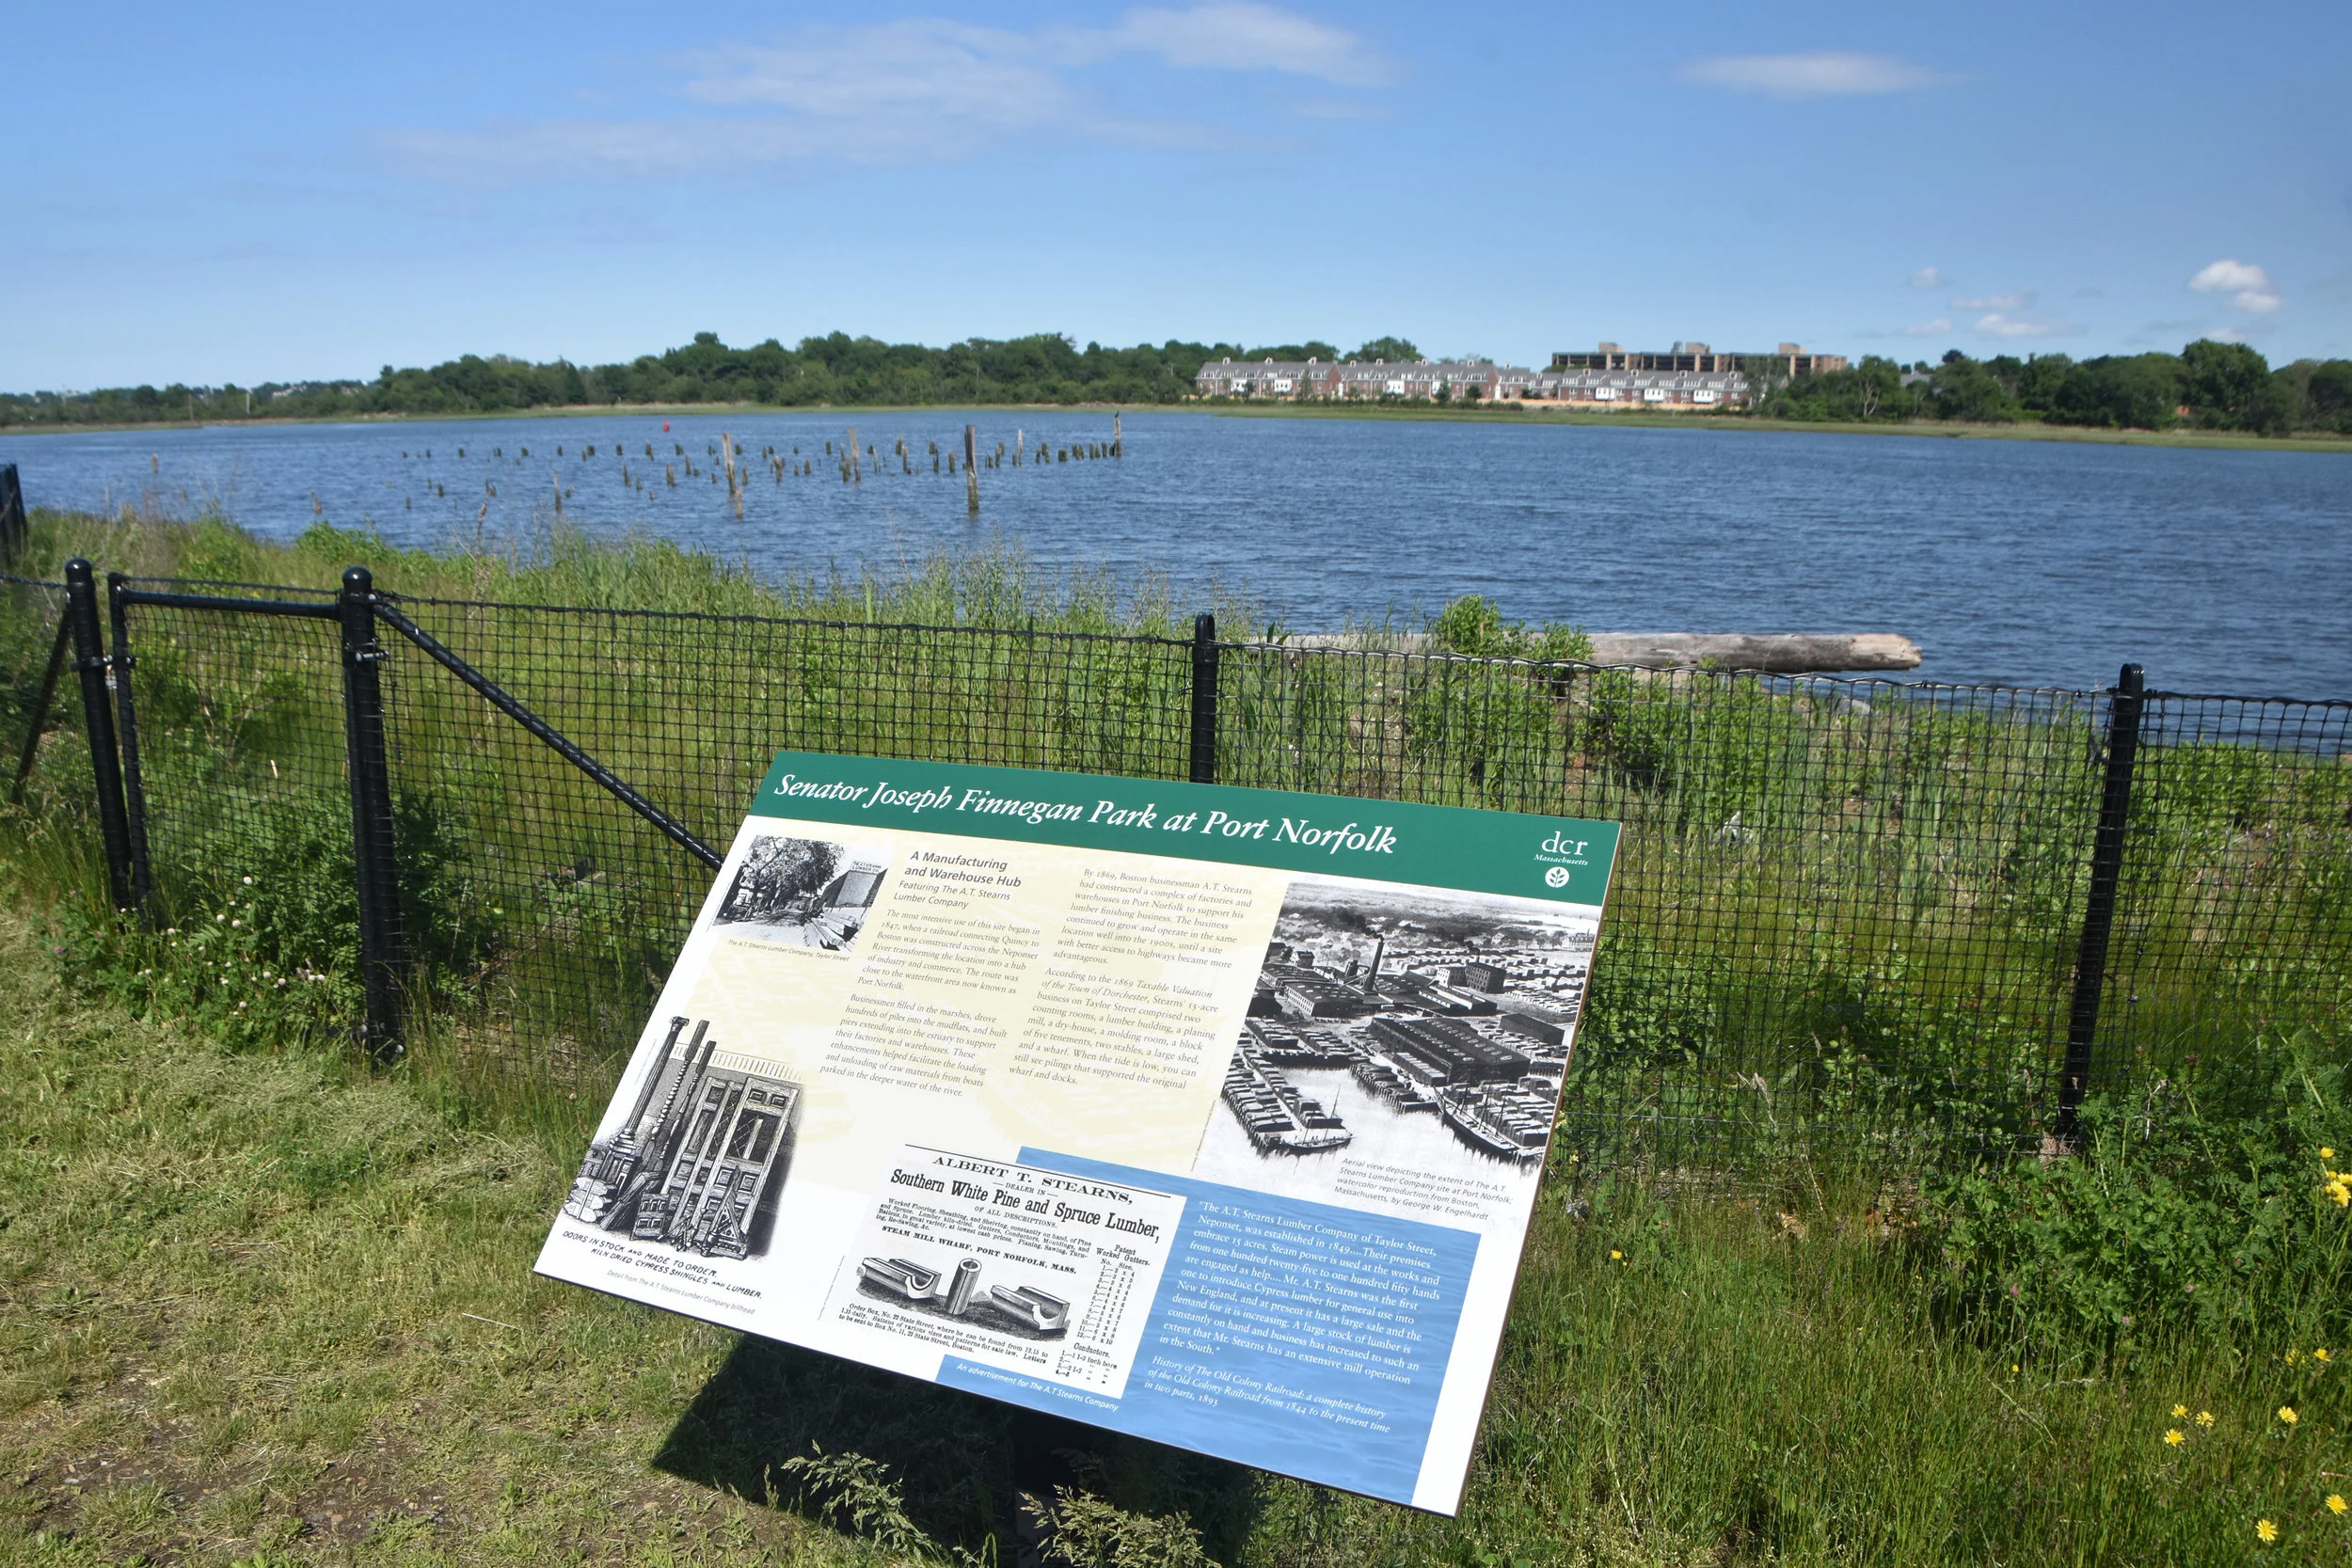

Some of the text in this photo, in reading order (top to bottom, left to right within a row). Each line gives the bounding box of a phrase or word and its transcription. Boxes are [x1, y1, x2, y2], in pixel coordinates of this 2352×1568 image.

[773, 773, 1397, 855] Senator Joseph Finnegan Park at Port Norfolk
[1541, 830, 1589, 856] dcr
[910, 850, 1009, 873] A Manufacturing
[1534, 853, 1588, 866] Massachusetts
[898, 879, 1010, 901] Featuring The A.T. Stearns
[904, 866, 1022, 888] and Warehouse Hub
[1083, 868, 1094, 879] By
[1096, 870, 1118, 880] 1869,
[1119, 872, 1148, 883] Boston
[1149, 875, 1200, 889] businessman
[1221, 884, 1253, 895] Stearns
[893, 892, 969, 911] Lumber Company
[1074, 893, 1120, 904] warehouses
[1132, 897, 1150, 908] Port
[1151, 900, 1184, 911] Norfolk
[1197, 908, 1230, 918] support
[1231, 910, 1245, 919] his
[881, 921, 900, 930] 1847,
[902, 923, 922, 932] when
[929, 927, 960, 937] railroad
[959, 932, 1000, 944] connecting
[1001, 935, 1030, 948] Quincy
[886, 909, 900, 918] The
[920, 915, 953, 925] intensive
[977, 920, 992, 929] this
[1008, 924, 1031, 935] began
[1044, 967, 1087, 982] According
[1098, 974, 1112, 984] the
[1114, 977, 1134, 988] 1869
[1136, 979, 1169, 992] Taxable
[1172, 985, 1213, 999] Valuation
[850, 993, 896, 1007] Businessmen
[897, 1000, 916, 1011] filled
[925, 1005, 939, 1014] the
[939, 1008, 972, 1021] marshes,
[974, 1012, 997, 1023] drove
[932, 1156, 1133, 1205] ALBERT T. STEARNS,
[1339, 1166, 1367, 1179] Stearns
[1368, 1172, 1397, 1183] Lumber
[1399, 1178, 1436, 1192] Company
[1461, 1188, 1479, 1198] Port
[1342, 1158, 1366, 1167] Aerial
[1366, 1162, 1385, 1171] view
[1385, 1165, 1422, 1180] depicting
[1438, 1176, 1464, 1185] extent
[1475, 1180, 1490, 1190] The
[1005, 1182, 1035, 1194] DEALER
[890, 1168, 1160, 1244] Southern White Pine and Spruce Lumber,
[1003, 1212, 1057, 1228] DESCRIPTIONS.
[1198, 1214, 1242, 1233] Neponset,
[1245, 1226, 1263, 1235] was
[1263, 1230, 1314, 1245] established
[1315, 1238, 1326, 1248] in
[1389, 1255, 1431, 1270] premises
[1242, 1210, 1275, 1224] Stearns
[1277, 1215, 1312, 1231] Lumber
[1314, 1224, 1359, 1243] Company
[1360, 1233, 1374, 1243] of
[1375, 1234, 1405, 1249] Taylor
[1406, 1242, 1437, 1258] Street,
[562, 1230, 589, 1243] DOORS
[598, 1240, 626, 1253] STOCK
[644, 1252, 671, 1265] MADE
[673, 1259, 685, 1269] TO
[685, 1263, 718, 1278] ORDER.
[882, 1225, 1076, 1275] STEAM MILL WHARF, PORT NORFOLK, MASS.
[1096, 1247, 1151, 1266] Worked Gutters.
[1114, 1243, 1136, 1256] Patent
[590, 1248, 610, 1258] KILN
[609, 1252, 633, 1264] DRIED
[635, 1259, 670, 1275] CYPRESS
[669, 1268, 708, 1285] SHINGLES
[725, 1284, 762, 1299] LUMBER.
[1073, 1341, 1110, 1358] Conductors.
[956, 1363, 968, 1372] An
[967, 1367, 1017, 1386] advertisement
[1017, 1378, 1029, 1387] for
[1029, 1382, 1043, 1392] The
[1057, 1388, 1084, 1402] Stearns
[1084, 1396, 1120, 1413] Company
[1152, 1354, 1184, 1372] History
[1184, 1364, 1198, 1374] of
[1196, 1365, 1213, 1377] The
[1214, 1370, 1232, 1382] Old
[1232, 1374, 1263, 1391] Colony
[1264, 1382, 1305, 1400] Railroad:
[1313, 1396, 1354, 1411] complete
[1354, 1402, 1387, 1420] history
